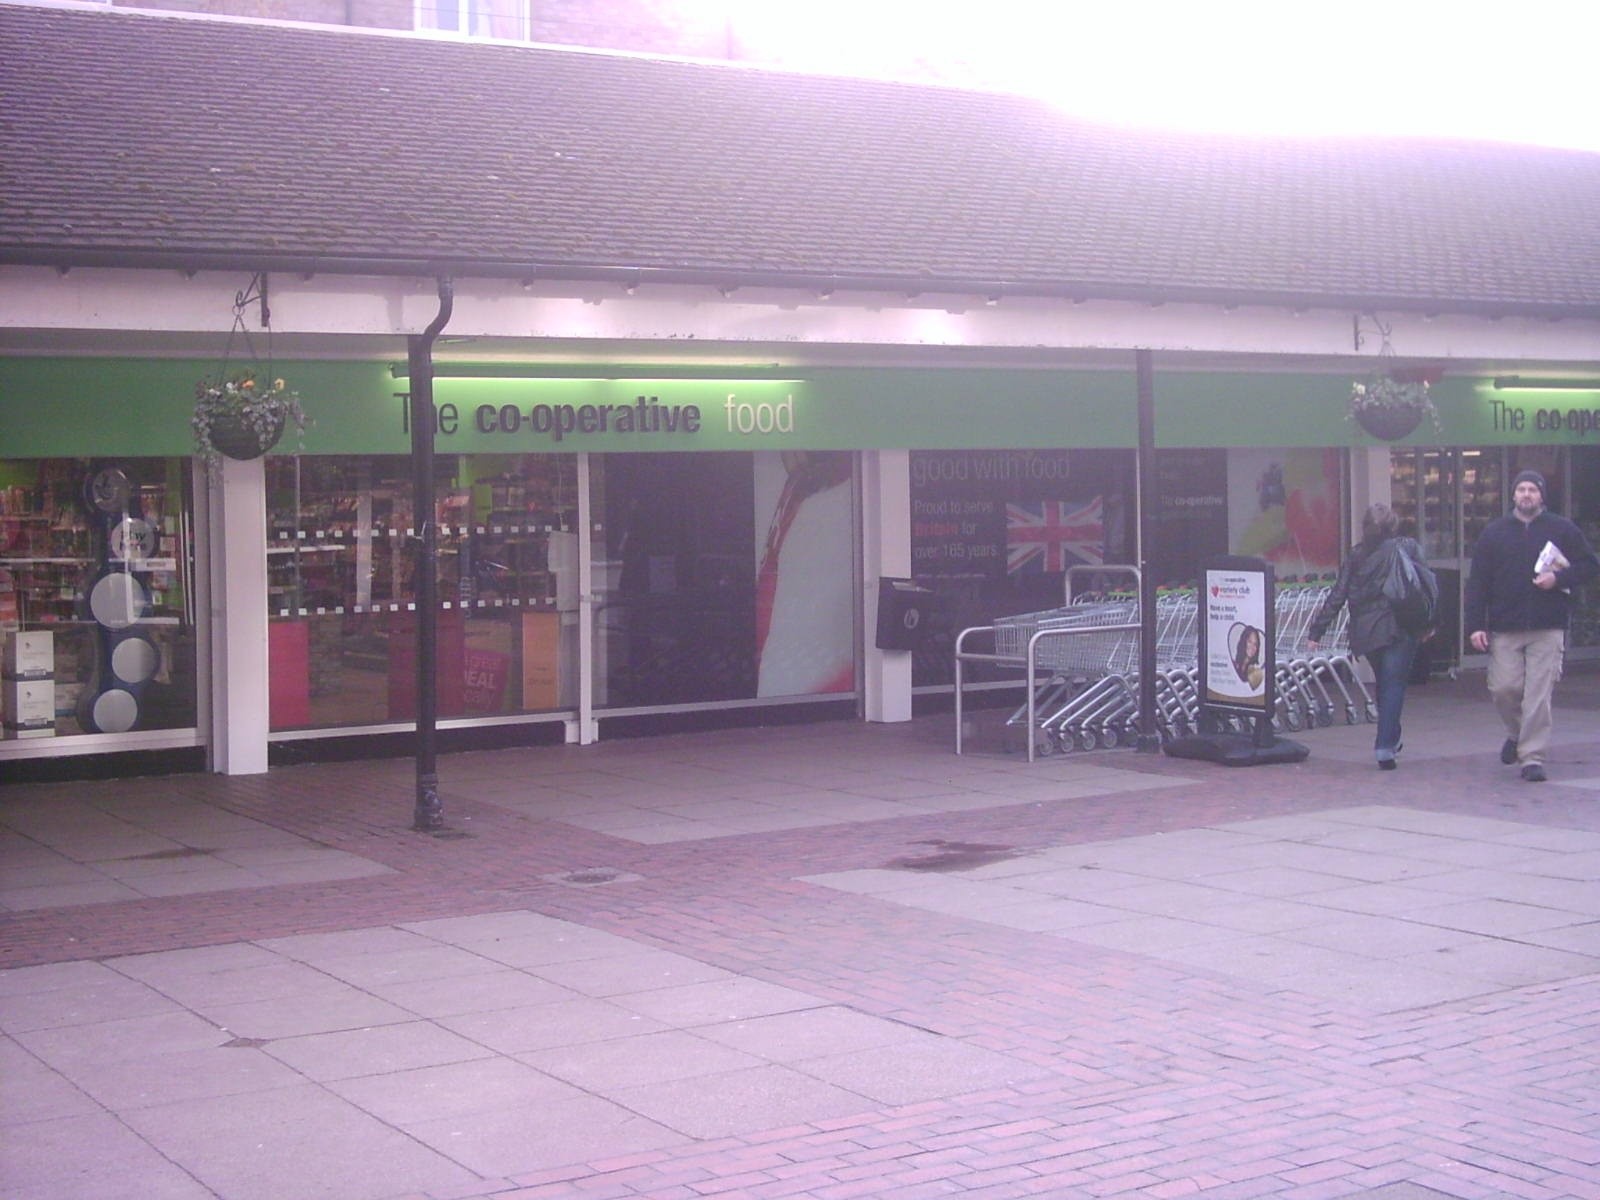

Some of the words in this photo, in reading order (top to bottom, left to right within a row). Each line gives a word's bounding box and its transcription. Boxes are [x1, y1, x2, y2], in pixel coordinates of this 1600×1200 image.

[393, 392, 458, 434] Te
[475, 395, 701, 441] co-operative
[724, 394, 793, 434] food
[1488, 399, 1525, 431] The
